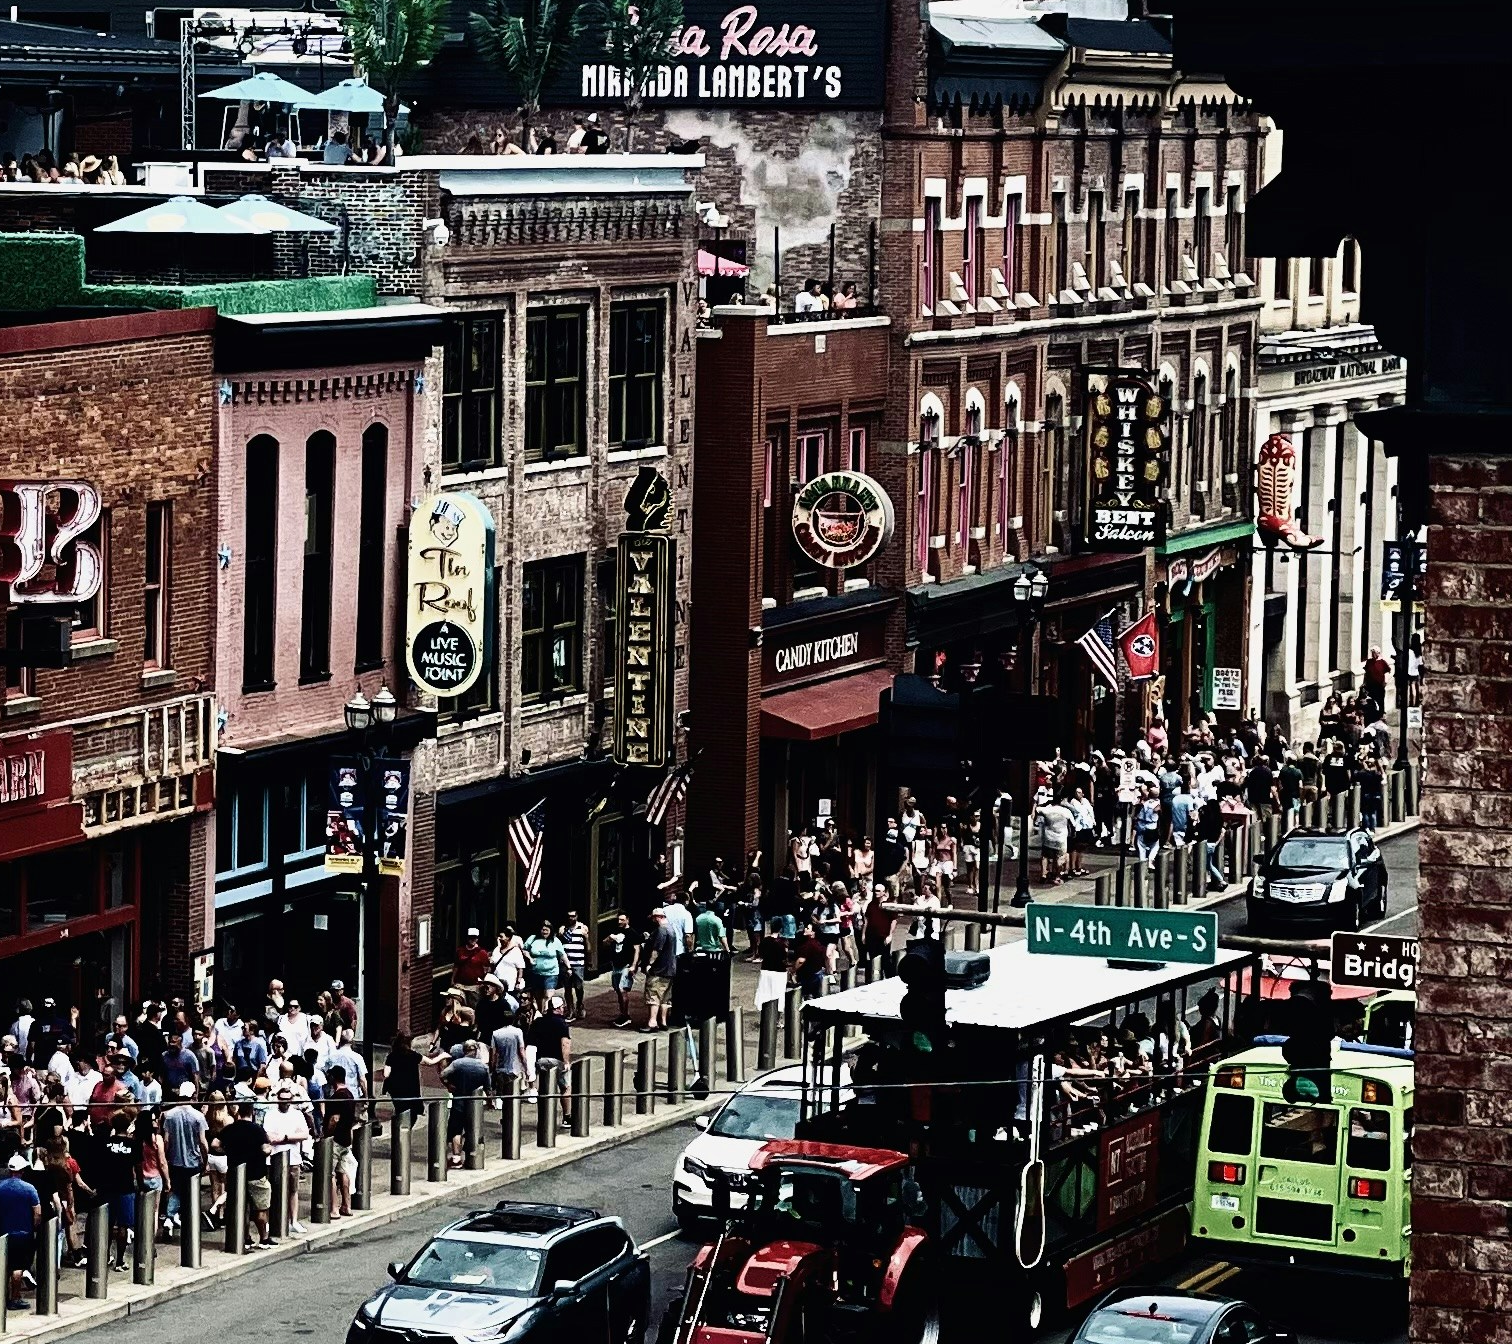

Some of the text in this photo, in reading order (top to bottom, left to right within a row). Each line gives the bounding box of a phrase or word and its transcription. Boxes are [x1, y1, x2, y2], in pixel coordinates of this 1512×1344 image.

[720, 5, 818, 60] Rosa
[698, 65, 841, 98] LAMBERT'S
[1294, 367, 1336, 386] BROADWAY
[1340, 360, 1376, 378] NATIONAL
[1115, 388, 1140, 506] WHISKEY
[1095, 510, 1155, 525] BENT
[420, 547, 470, 580] Tin
[413, 581, 478, 623] Roof
[430, 637, 459, 650] LIVE
[439, 623, 449, 634] A
[421, 650, 467, 667] MUSIC
[627, 550, 655, 763] VALENTINE
[776, 631, 858, 672] CANDY KITCHEN
[424, 666, 465, 681] JOINT
[1035, 916, 1207, 952] N-4th Ave-S
[1402, 941, 1419, 958] HO
[1345, 954, 1414, 988] Bridg
